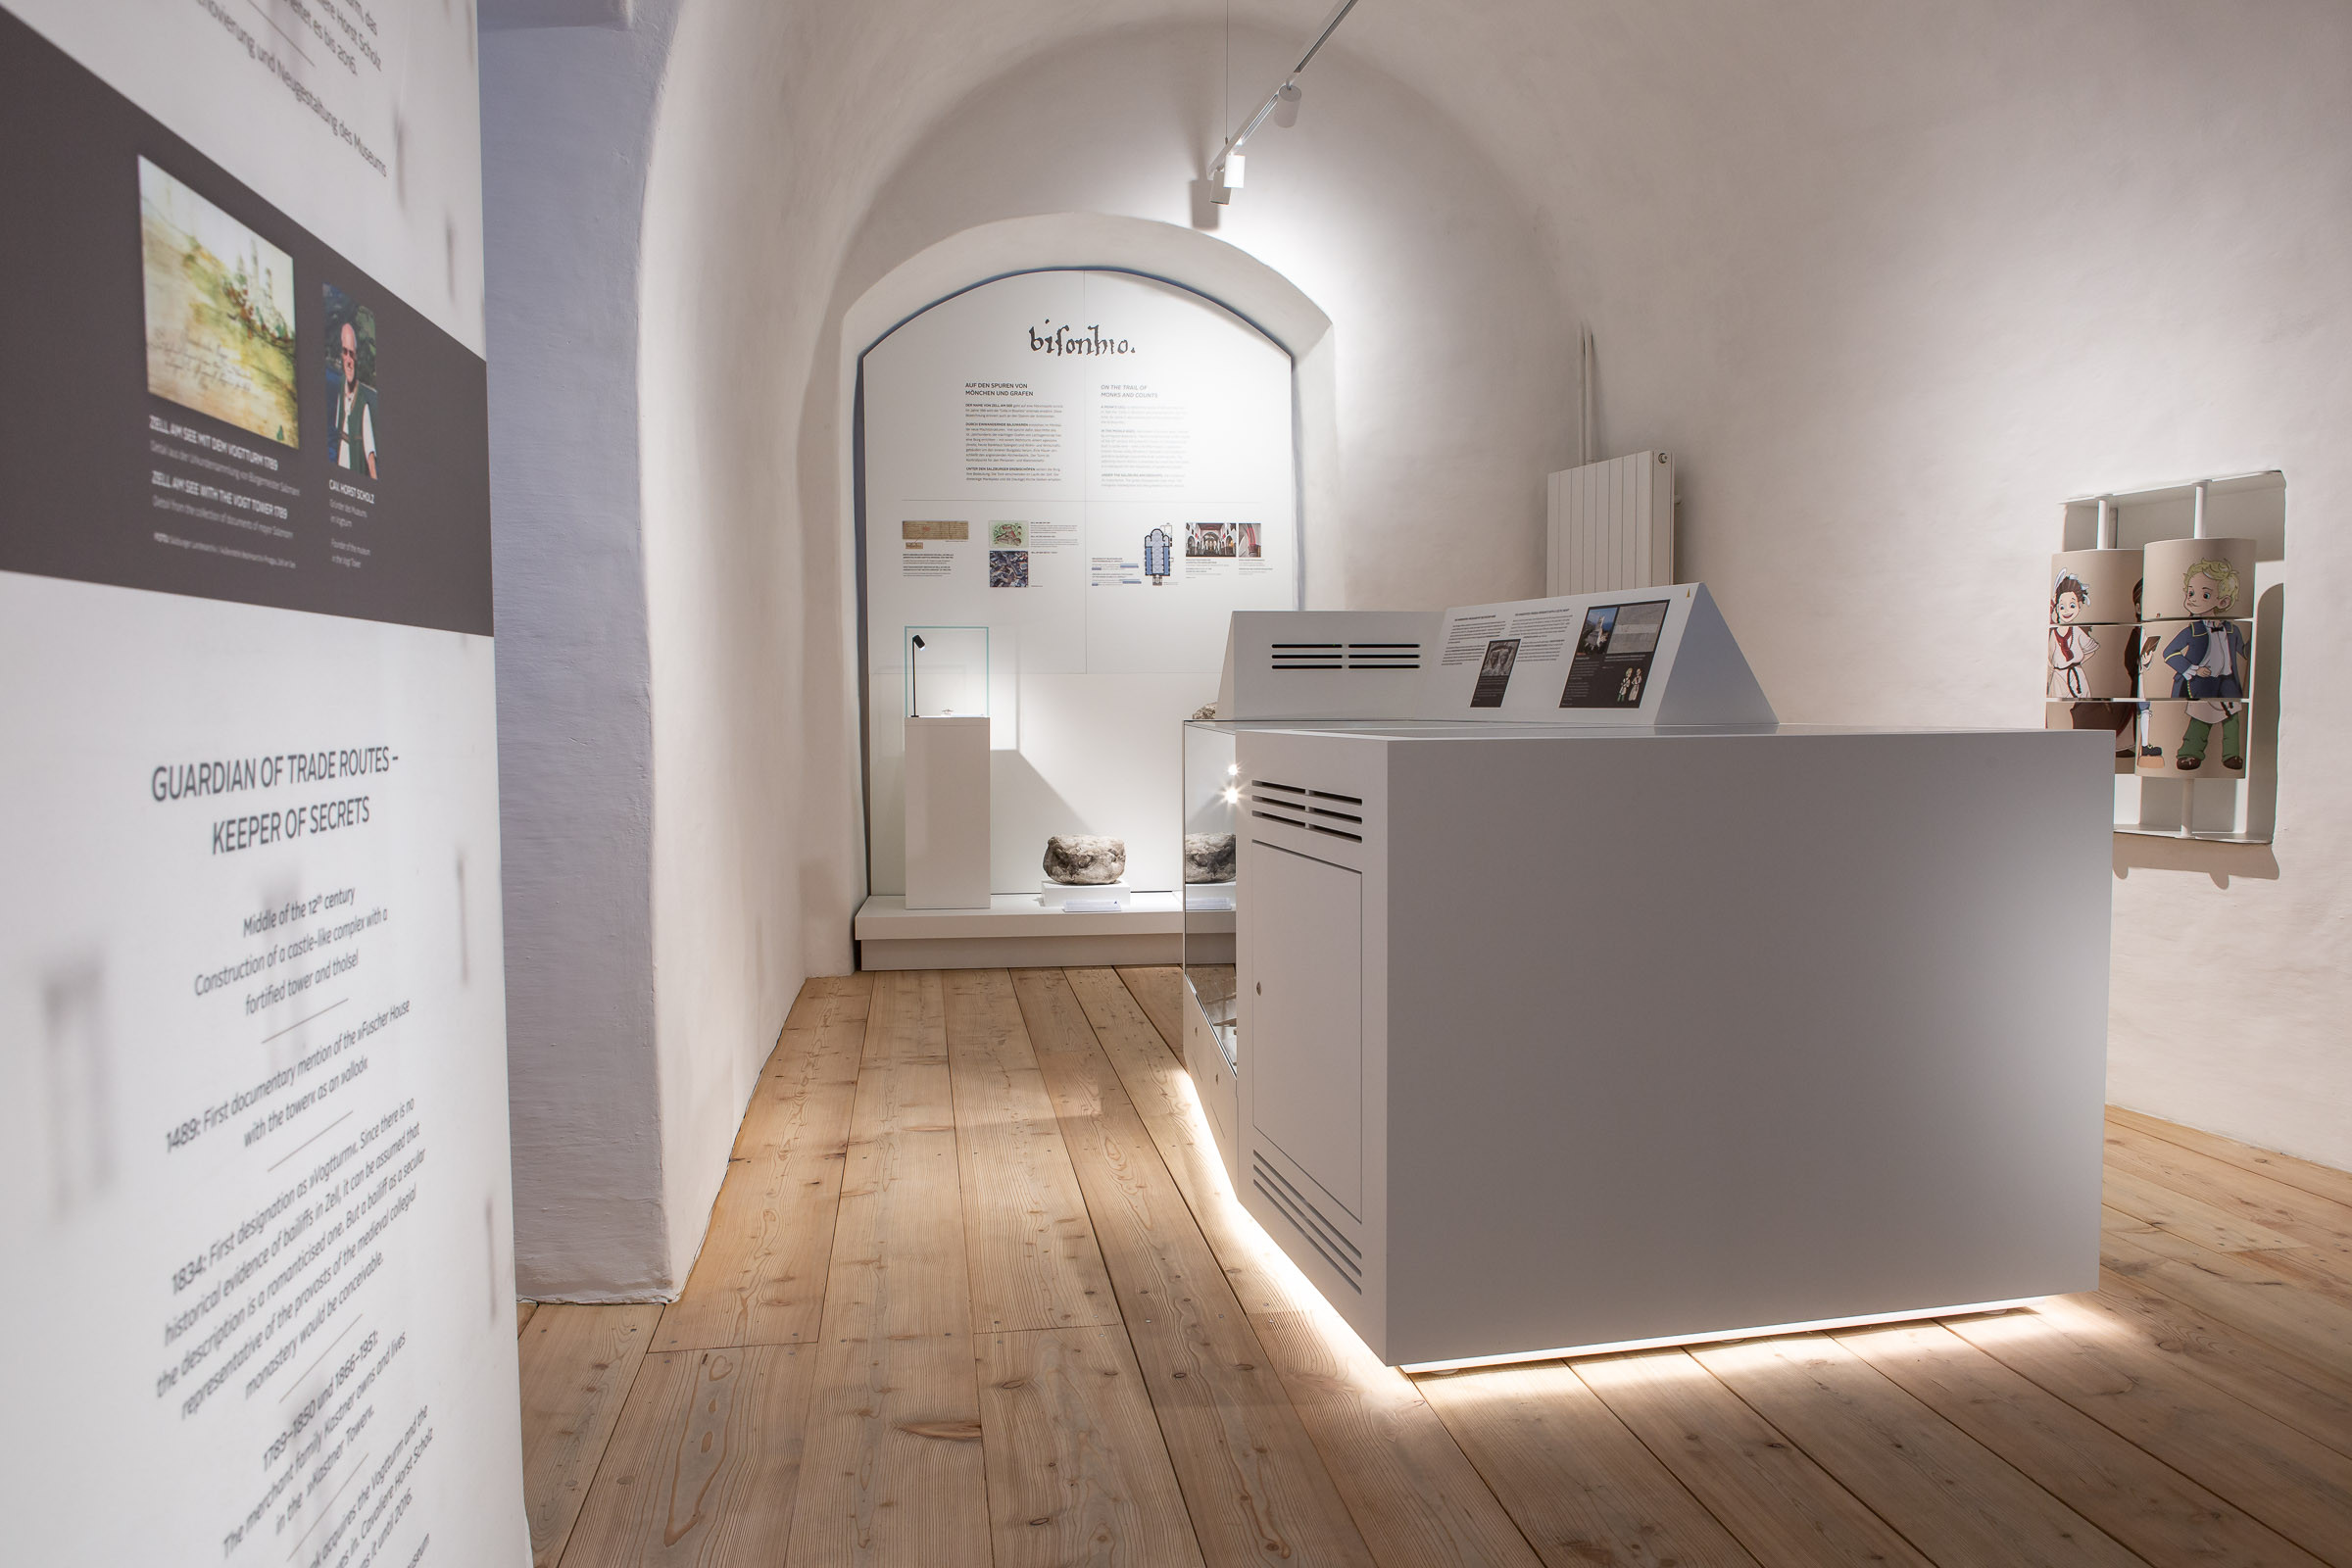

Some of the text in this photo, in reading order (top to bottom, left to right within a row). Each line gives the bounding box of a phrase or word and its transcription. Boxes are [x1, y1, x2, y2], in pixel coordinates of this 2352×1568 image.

[257, 44, 387, 177] und Neugestaltung des Museums
[171, 423, 183, 437] AM
[183, 427, 197, 444] SEE
[198, 434, 212, 448] MIT
[212, 438, 227, 453] DEM
[151, 469, 172, 488] ZELL
[172, 477, 185, 491] AM
[185, 479, 199, 496] SEE
[200, 486, 219, 501] WITH
[220, 489, 233, 505] THE
[233, 494, 251, 509] VOGT
[252, 499, 273, 515] TOWER
[357, 489, 375, 504] SCHOLZ
[152, 758, 256, 802] GUARDIAN
[261, 756, 283, 788] OF
[288, 751, 336, 784] TRADE
[339, 746, 389, 777] ROUTES
[213, 796, 369, 855] KEEPER OF SECRETS
[194, 908, 388, 997] Construction of a castle-like complex with a
[243, 908, 277, 938] Middle
[278, 903, 289, 925] of
[291, 901, 306, 921] the
[324, 888, 355, 909] century
[246, 949, 359, 1016] fortified tower and tholsel
[166, 1116, 201, 1153] 1489:
[203, 1101, 228, 1133] First
[231, 1066, 295, 1116] documentary
[297, 1045, 332, 1078] mention
[334, 1033, 343, 1055] of
[343, 1030, 356, 1050] the
[390, 1000, 410, 1023] House
[244, 1119, 266, 1148] with
[269, 1106, 283, 1133] the
[318, 1083, 327, 1100] as
[328, 1076, 339, 1094] an
[165, 1280, 220, 1347] historical
[222, 1247, 269, 1298] evidence
[270, 1230, 282, 1257] of
[283, 1207, 314, 1248] bailiffs
[316, 1201, 323, 1221] in
[343, 1178, 349, 1196] it
[350, 1169, 365, 1191] can
[366, 1160, 374, 1178] be
[375, 1130, 406, 1169] assumed
[406, 1121, 419, 1144] that
[172, 1253, 207, 1296] 1834:
[209, 1231, 235, 1266] First
[237, 1188, 295, 1245] designation
[297, 1179, 307, 1199] as
[360, 1124, 379, 1150] Since
[380, 1109, 398, 1134] there
[399, 1102, 406, 1118] is
[406, 1098, 415, 1110] no
[157, 1364, 178, 1398] the
[180, 1306, 246, 1375] description
[247, 1296, 256, 1318] is
[258, 1290, 265, 1307] a
[267, 1231, 325, 1299] romanticised
[346, 1204, 360, 1229] But
[361, 1200, 367, 1215] a
[368, 1176, 388, 1209] bailiff
[388, 1174, 397, 1191] as
[398, 1169, 403, 1183] a
[403, 1148, 425, 1178] secular
[181, 1182, 416, 1421] representative of the provosts of the medieval collegial
[245, 1335, 299, 1400] monastery
[299, 1304, 325, 1344] would
[325, 1291, 337, 1315] be
[223, 1525, 243, 1560] The
[246, 1464, 293, 1533] merchant
[295, 1430, 322, 1474] family
[357, 1369, 375, 1399] owns
[376, 1349, 390, 1375] and
[391, 1332, 406, 1360] lives
[358, 1486, 370, 1510] the
[405, 1416, 416, 1445] and
[417, 1405, 428, 1426] the
[395, 1455, 413, 1491] Horst
